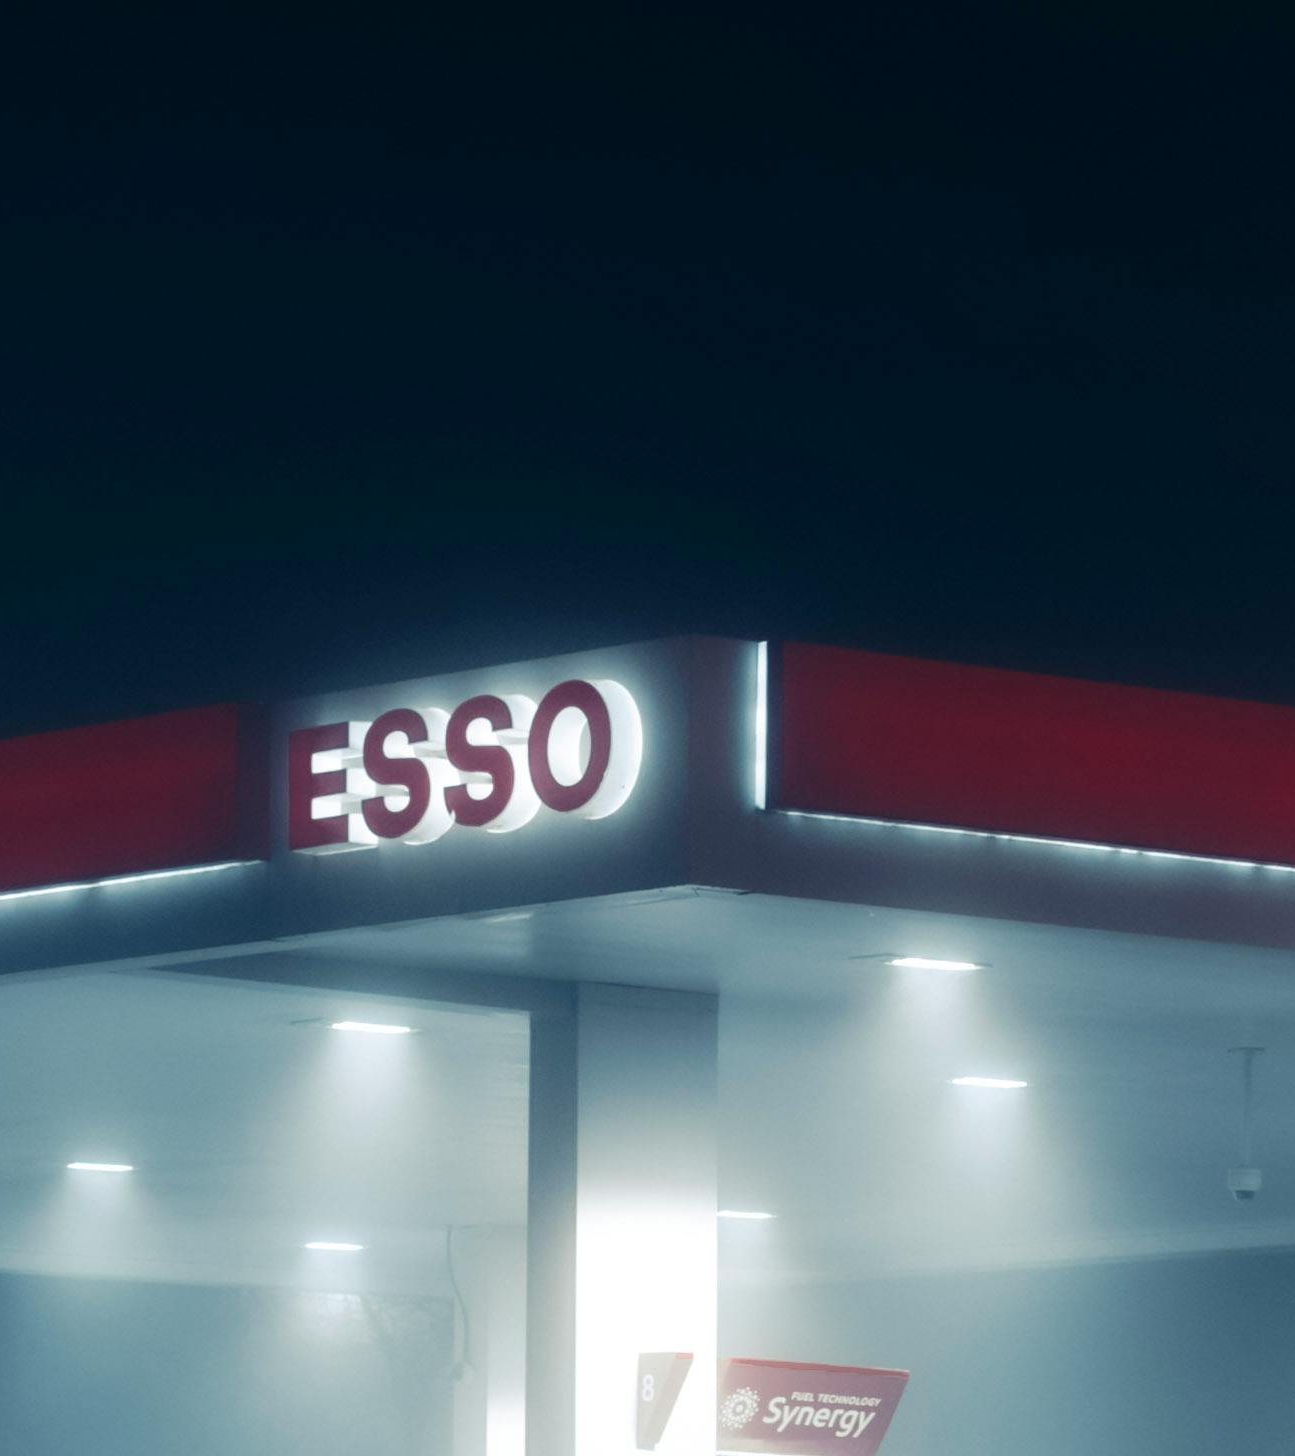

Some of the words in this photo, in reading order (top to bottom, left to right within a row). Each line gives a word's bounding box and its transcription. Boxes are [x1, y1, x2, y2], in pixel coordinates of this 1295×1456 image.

[289, 679, 612, 851] ESSO
[642, 1373, 654, 1401] 8
[791, 1391, 815, 1403] FUEL
[817, 1392, 882, 1408] TECHNOLOGY
[762, 1396, 877, 1438] Synergy
